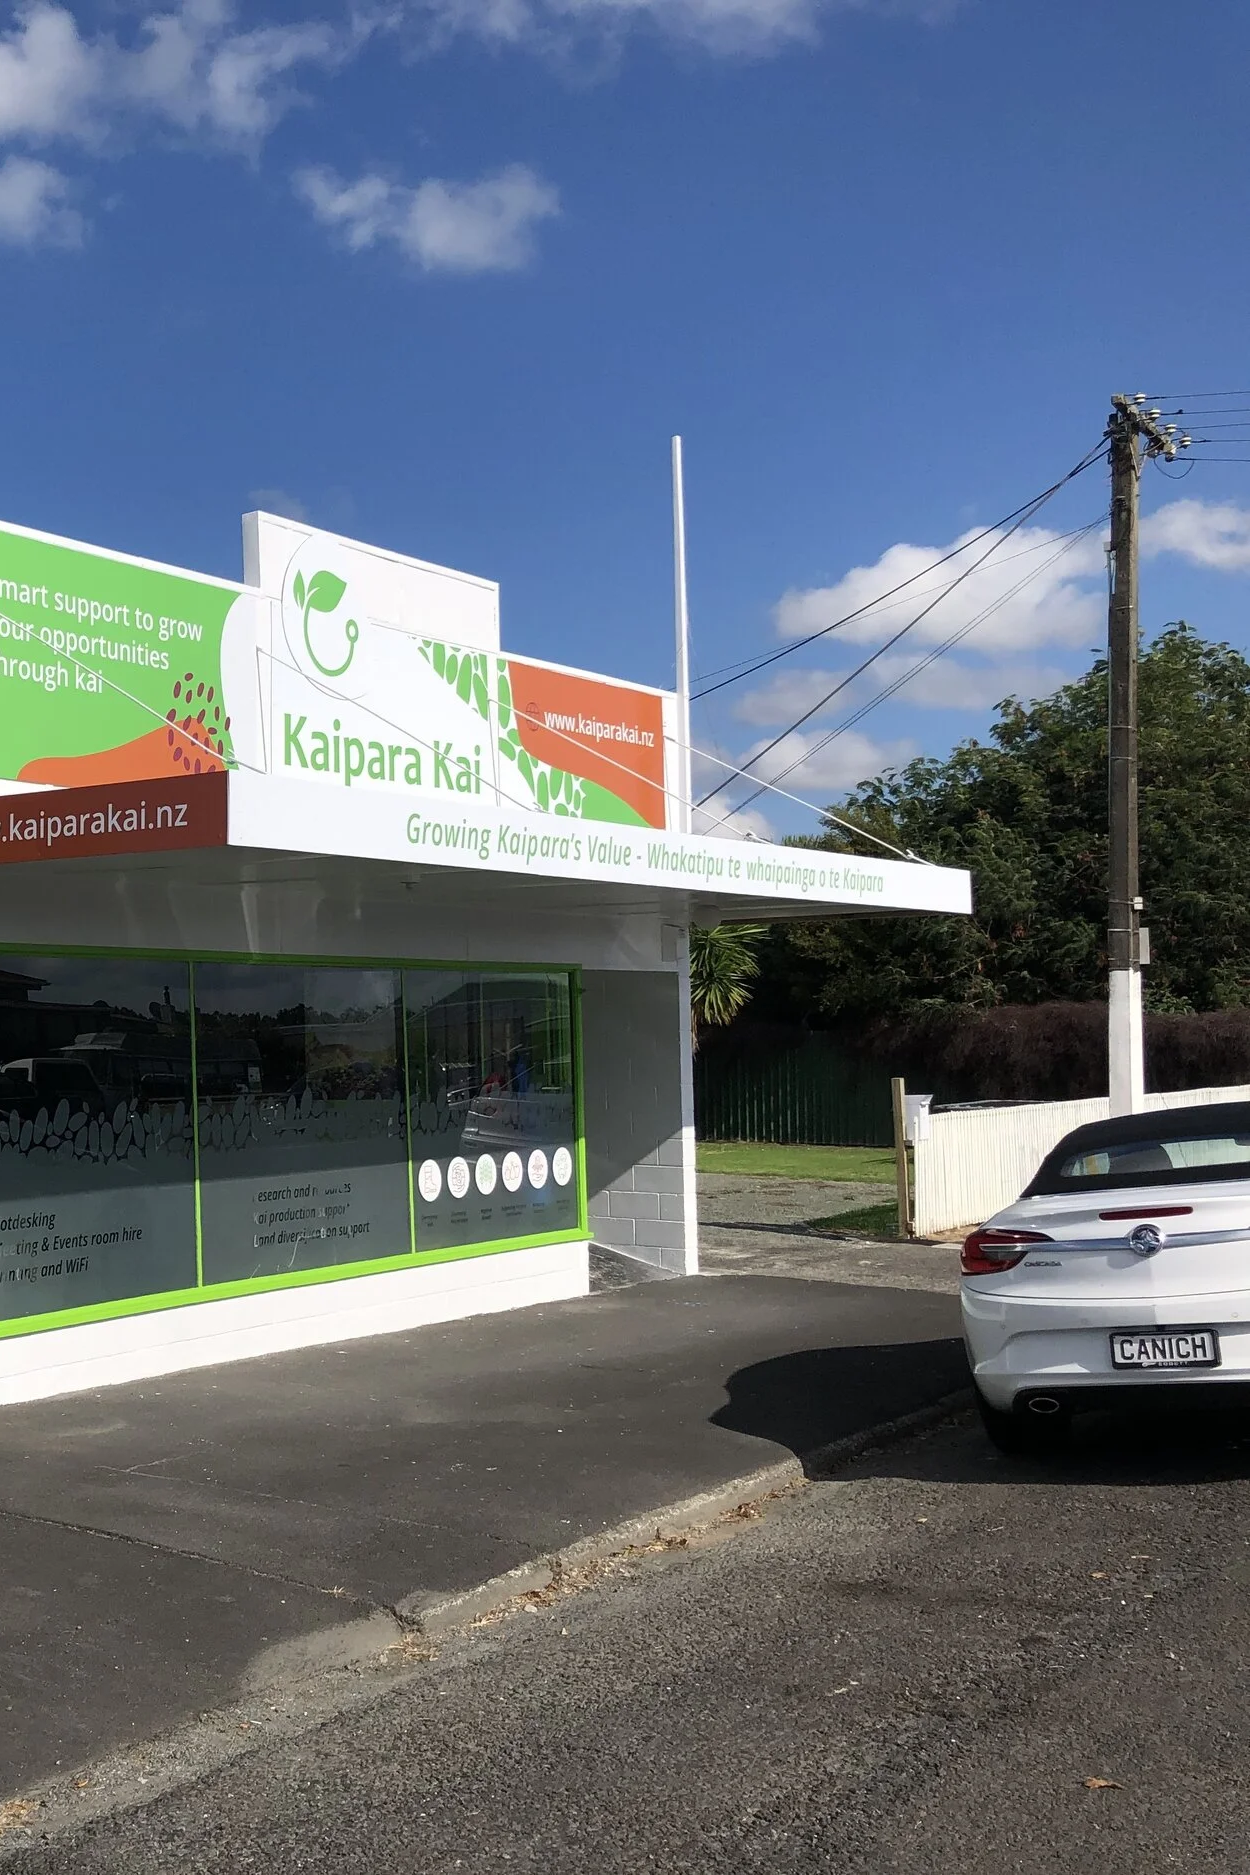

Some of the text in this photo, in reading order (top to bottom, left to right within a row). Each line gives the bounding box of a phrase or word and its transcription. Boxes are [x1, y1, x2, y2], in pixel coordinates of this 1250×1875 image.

[54, 591, 129, 626] support
[135, 608, 153, 631] to
[158, 616, 203, 641] grow
[40, 626, 169, 670] opportunities
[75, 665, 102, 693] kai
[544, 712, 654, 747] www.kaiparakai.nz
[284, 713, 481, 795] Kaipara Kai
[406, 813, 491, 860] Growing
[497, 824, 582, 865] Kaipara's
[588, 835, 632, 866] Value
[647, 843, 723, 883] Whakatipu
[728, 855, 741, 879] te
[746, 856, 816, 893] whaipainga
[819, 872, 825, 886] o
[829, 869, 840, 889] te
[843, 868, 883, 896] Kaipara
[294, 1184, 310, 1198] and
[269, 1208, 316, 1227] production
[41, 1237, 49, 1252] &
[53, 1234, 89, 1251] Events
[91, 1230, 119, 1246] room
[122, 1227, 143, 1242] hire
[41, 1260, 63, 1277] and
[65, 1256, 89, 1273] WiFi
[1120, 1336, 1207, 1361] CANICH
